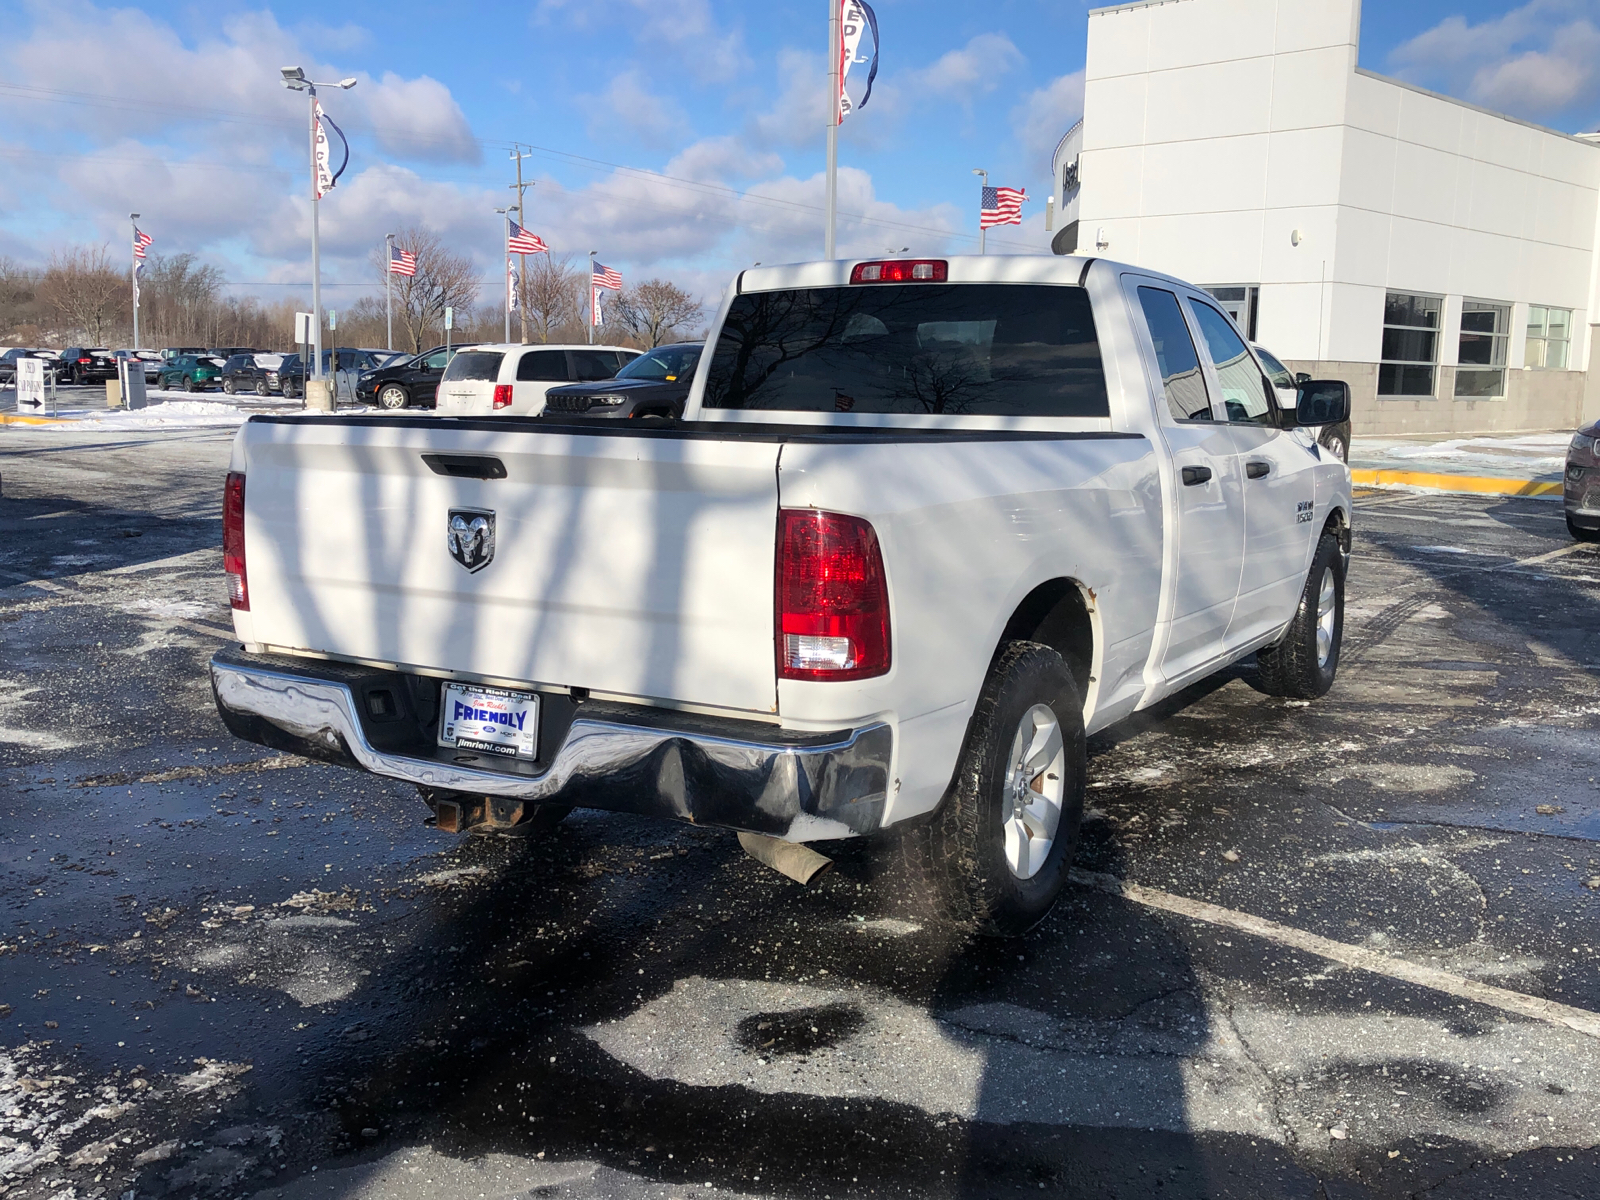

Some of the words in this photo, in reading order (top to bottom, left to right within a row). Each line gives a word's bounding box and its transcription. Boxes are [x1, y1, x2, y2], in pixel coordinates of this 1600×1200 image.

[1297, 499, 1314, 512] RAM
[1297, 510, 1313, 524] 1500
[485, 688, 509, 697] Riehl
[510, 692, 532, 700] Deal
[472, 699, 485, 708] Jim
[453, 699, 528, 731] FRIENDLY
[457, 739, 516, 754] jimriehl.com
